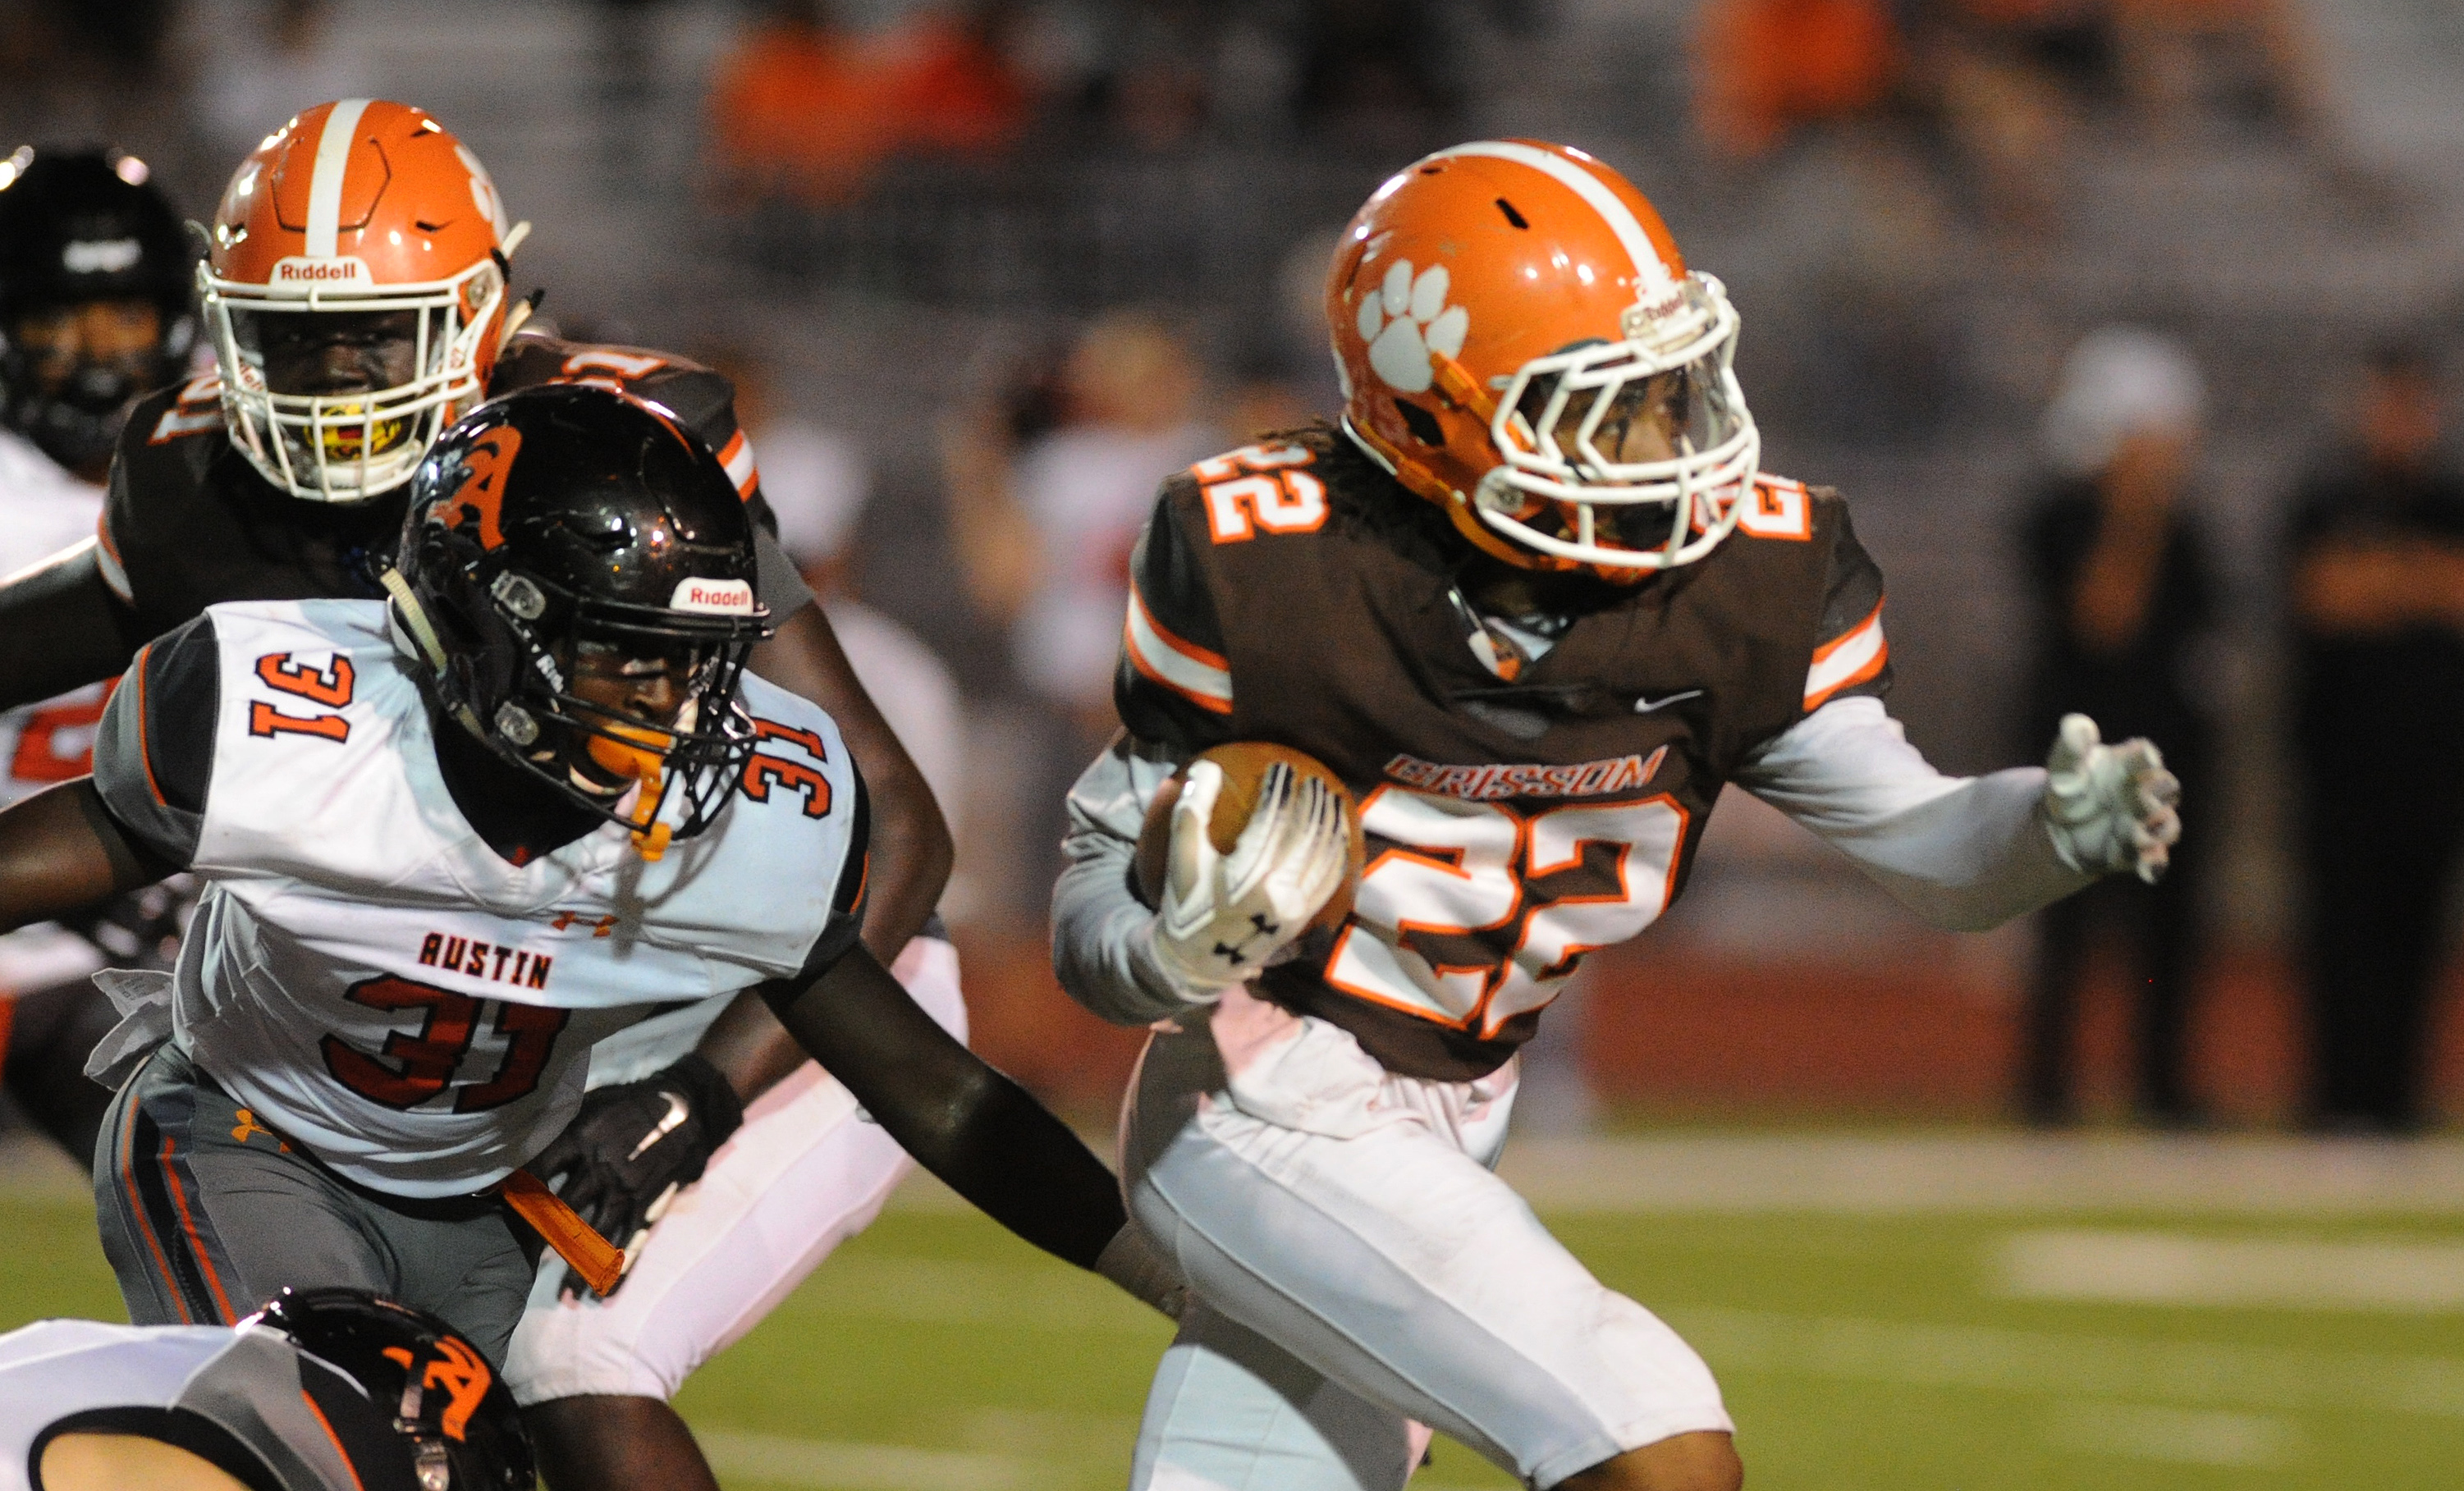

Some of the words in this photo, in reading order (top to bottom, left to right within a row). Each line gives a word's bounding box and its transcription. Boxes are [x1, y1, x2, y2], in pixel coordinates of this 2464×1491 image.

[280, 263, 356, 280] Riddell
[424, 424, 523, 552] A
[1190, 443, 1331, 547] 22
[690, 587, 749, 606] Riddell
[249, 651, 355, 745] 31
[740, 716, 828, 821] 31
[1382, 744, 1669, 800] GRISSOM
[419, 931, 553, 991] AUSTIN
[1322, 781, 1691, 1040] 22
[318, 971, 573, 1114] 31
[381, 1334, 492, 1443] A
